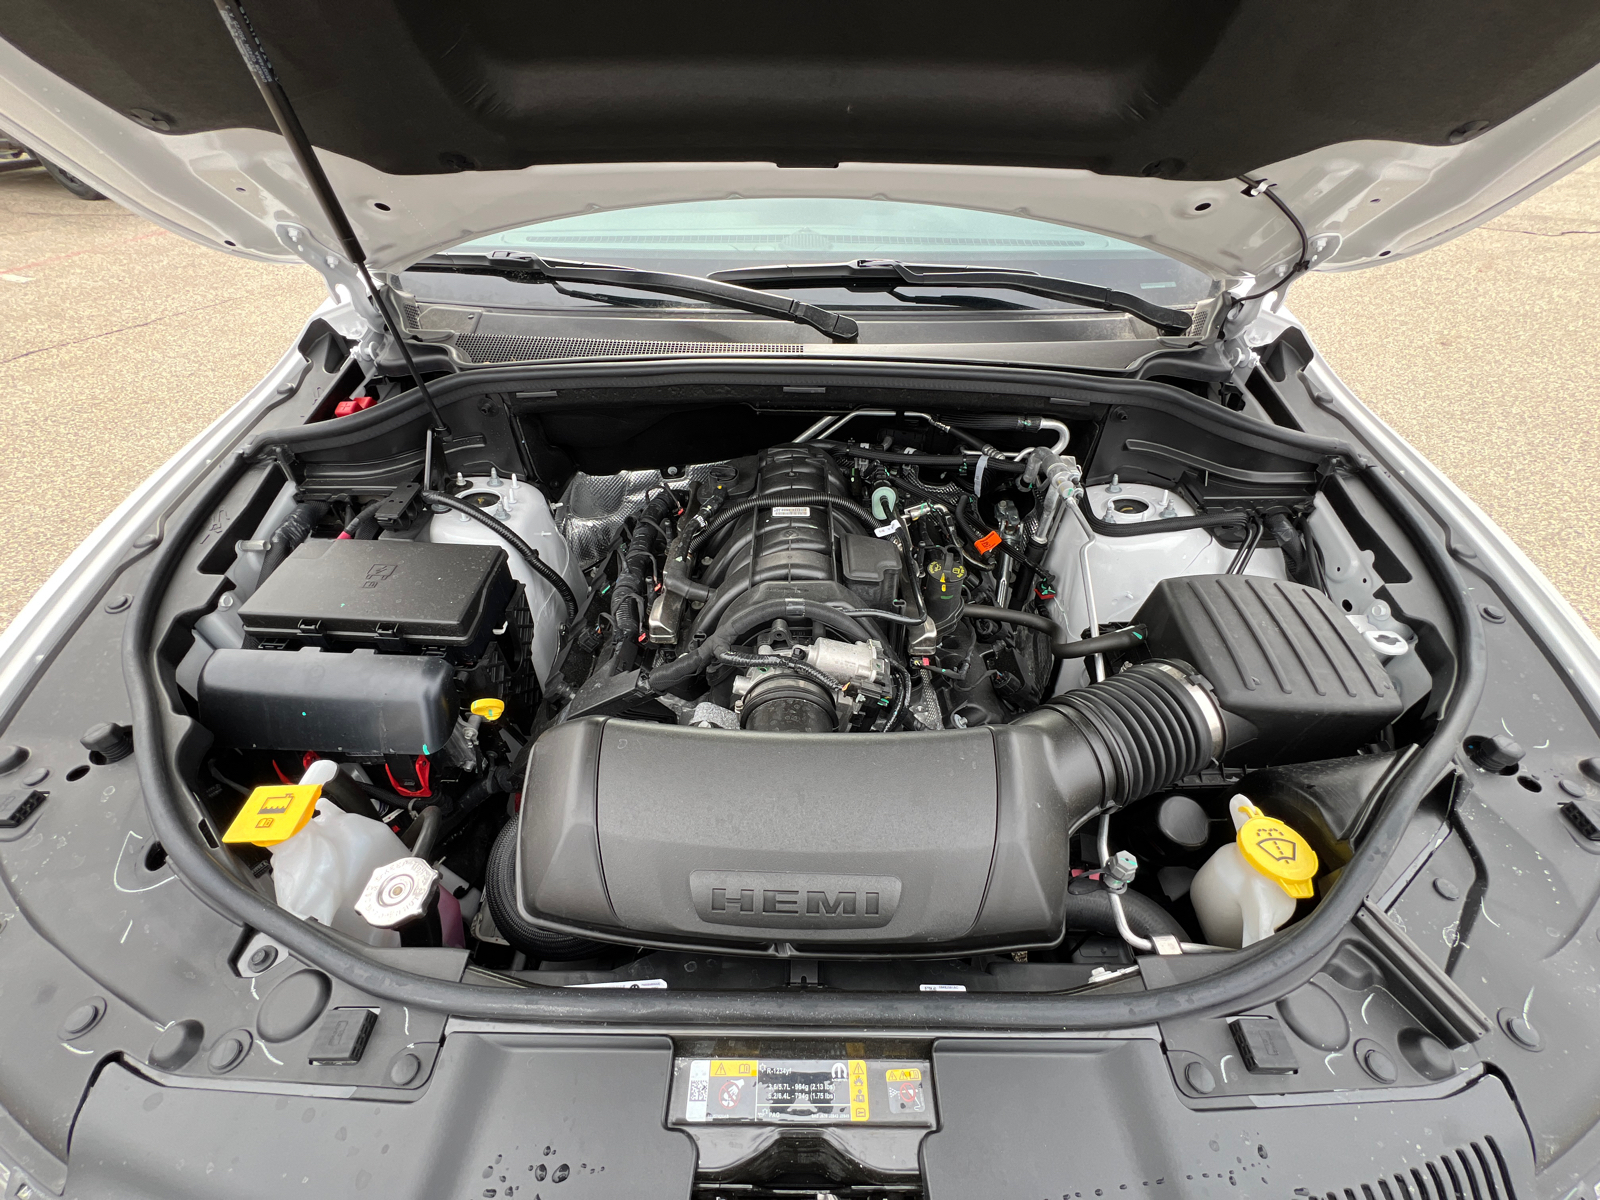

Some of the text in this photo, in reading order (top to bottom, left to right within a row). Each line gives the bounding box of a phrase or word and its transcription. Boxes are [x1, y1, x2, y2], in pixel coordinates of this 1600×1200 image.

[711, 888, 880, 917] HEMI
[810, 1083, 824, 1091] (2.13
[810, 1092, 824, 1100] (1.75
